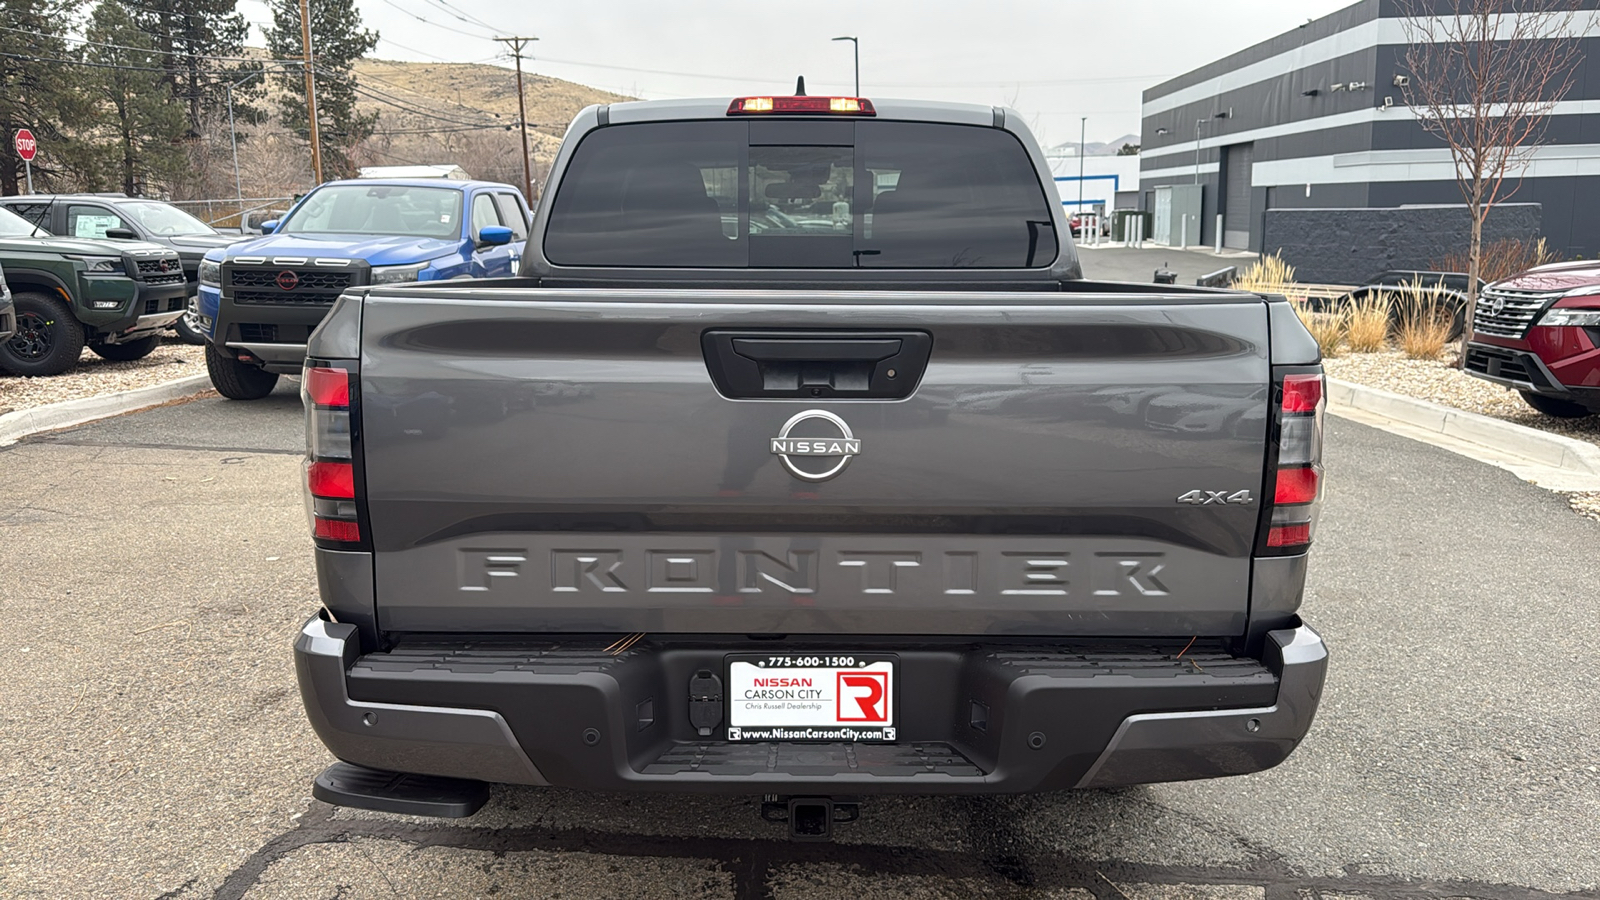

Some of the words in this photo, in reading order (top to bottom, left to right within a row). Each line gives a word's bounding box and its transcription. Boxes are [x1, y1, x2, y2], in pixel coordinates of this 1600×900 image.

[17, 138, 34, 150] STOP
[773, 441, 858, 453] NISSAN
[457, 548, 1170, 596] FRONTIER
[768, 657, 855, 667] 775-600-1500
[754, 678, 812, 687] NISSAN
[744, 689, 794, 700] CARSON
[797, 689, 823, 699] CITY
[745, 702, 762, 710] Chris
[763, 702, 786, 710] Russell
[787, 703, 822, 711] Dealership
[742, 728, 882, 741] www.NissanCarsonCity.com
